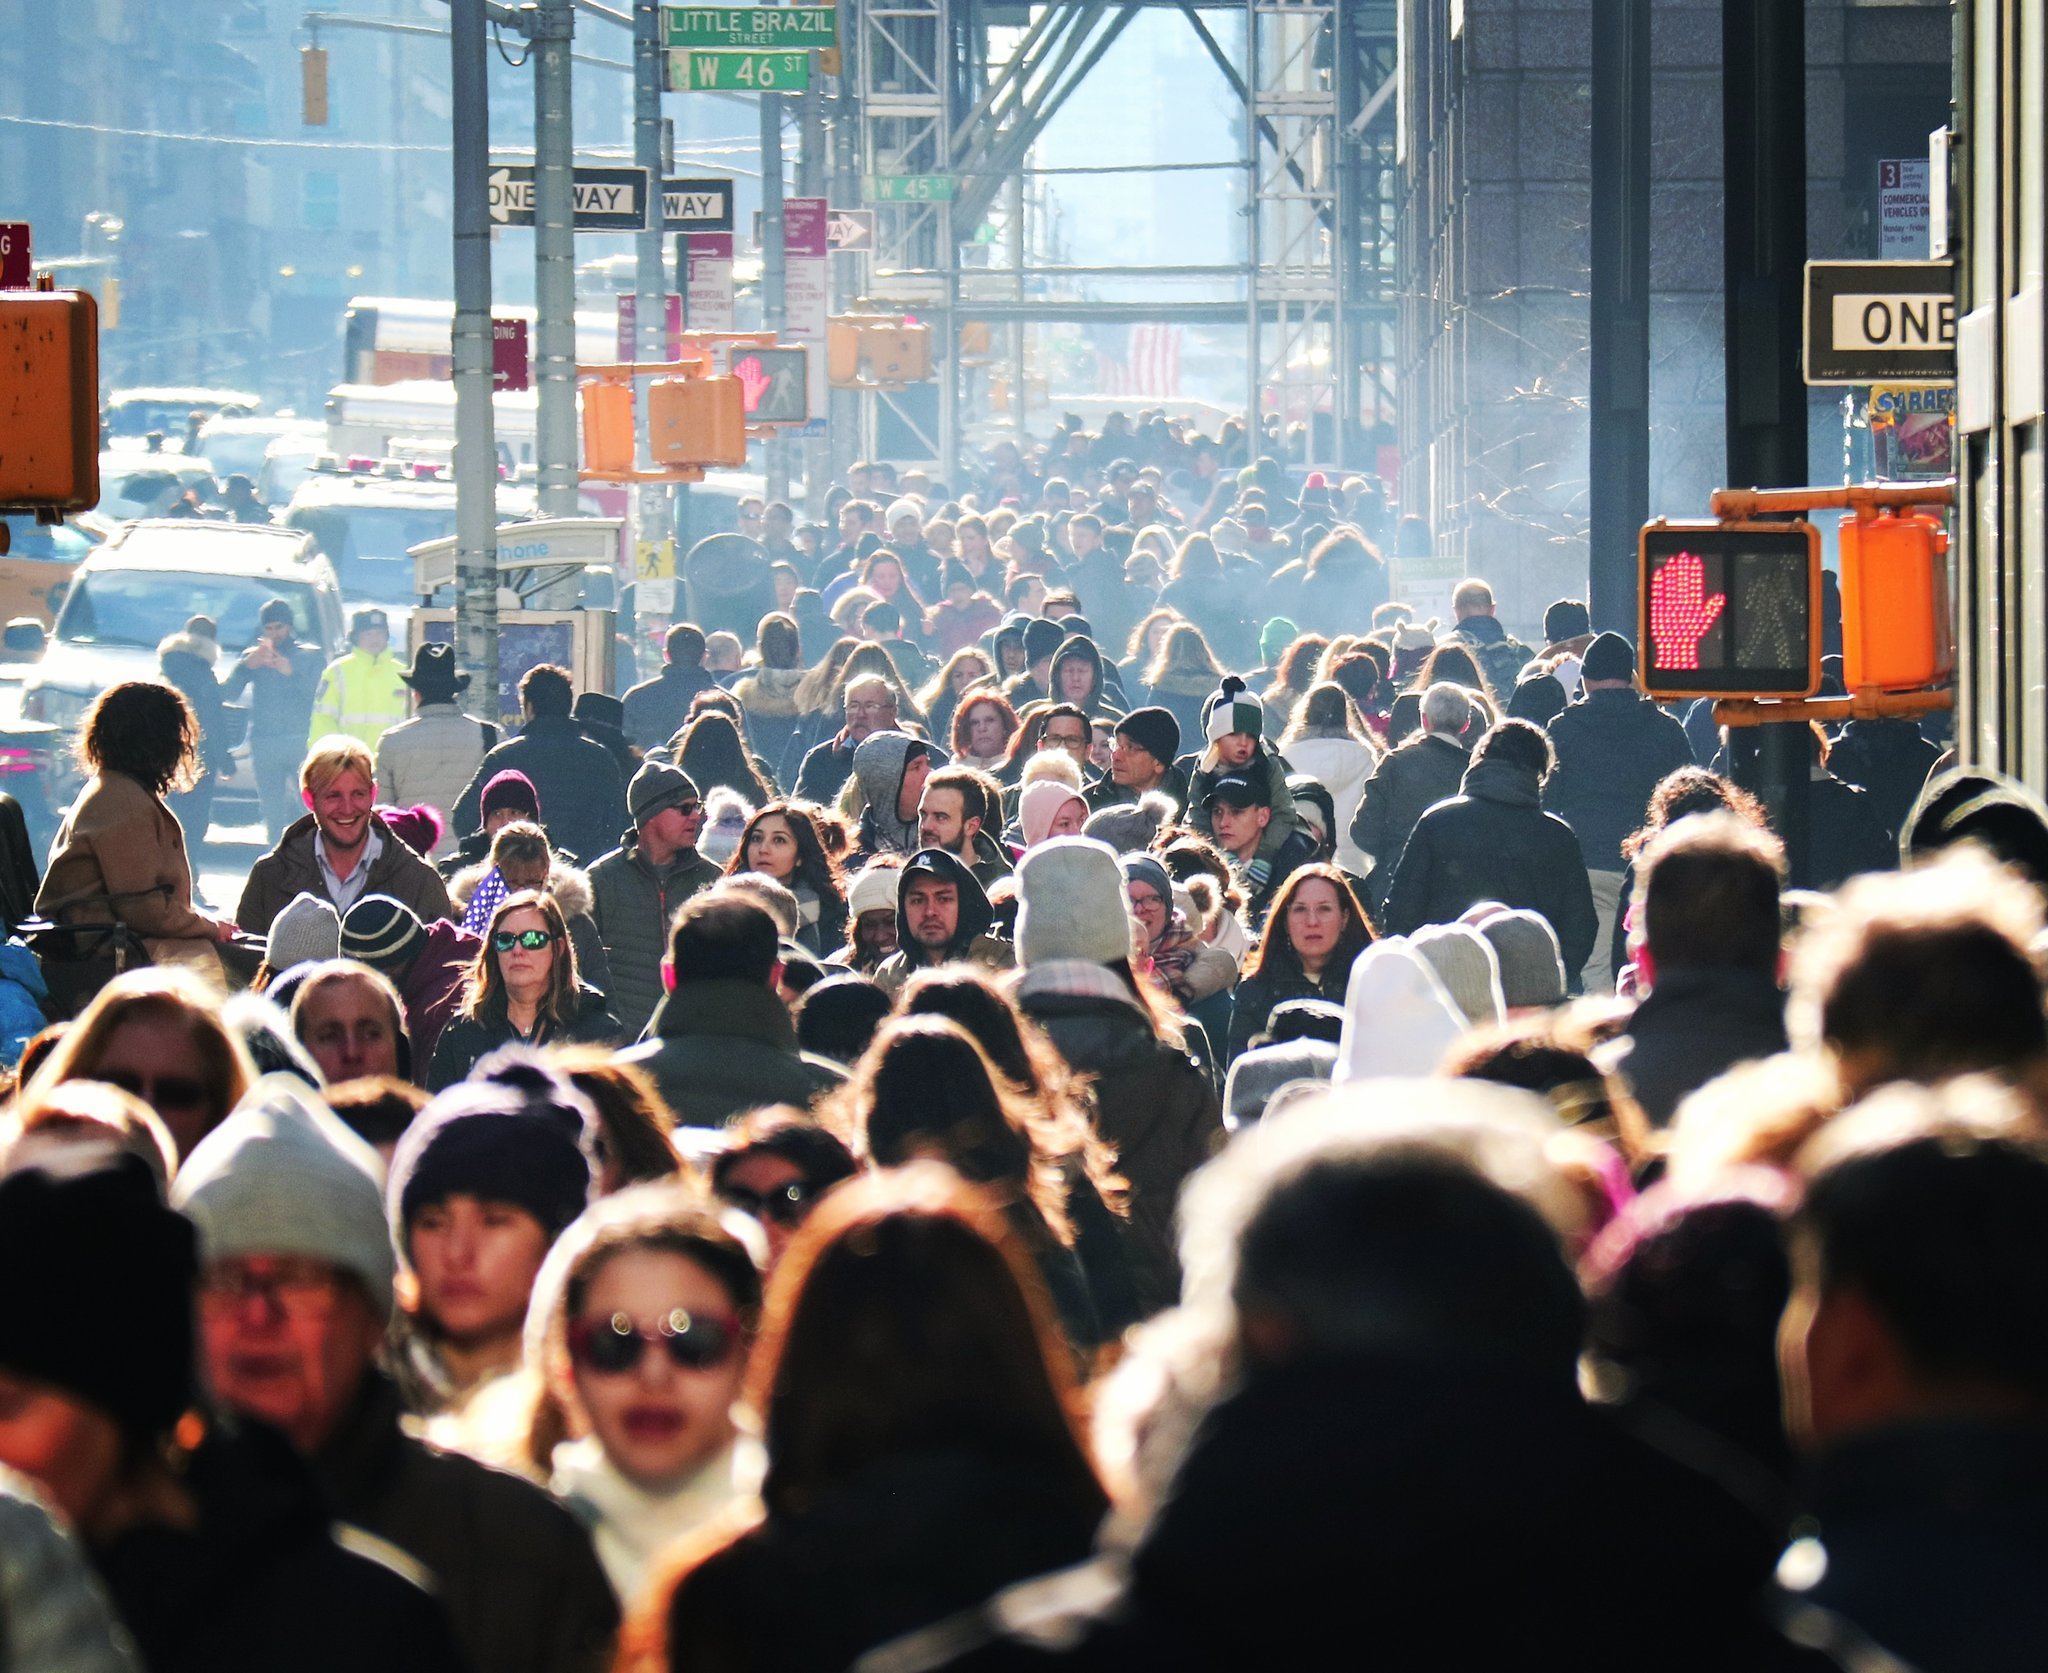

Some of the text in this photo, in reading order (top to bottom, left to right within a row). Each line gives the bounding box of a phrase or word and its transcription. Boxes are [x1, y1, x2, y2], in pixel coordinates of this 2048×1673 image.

[670, 11, 833, 32] LITTLE BRAZIL
[729, 33, 774, 44] STREET
[697, 56, 802, 87] W 46 ST
[1885, 165, 1896, 187] 3
[489, 185, 535, 207] ONE
[879, 179, 894, 199] W
[904, 179, 930, 199] 45
[663, 196, 712, 216] WAY
[1883, 206, 1918, 218] VEHICLES
[1863, 301, 1955, 344] ONE
[497, 542, 549, 560] hone
